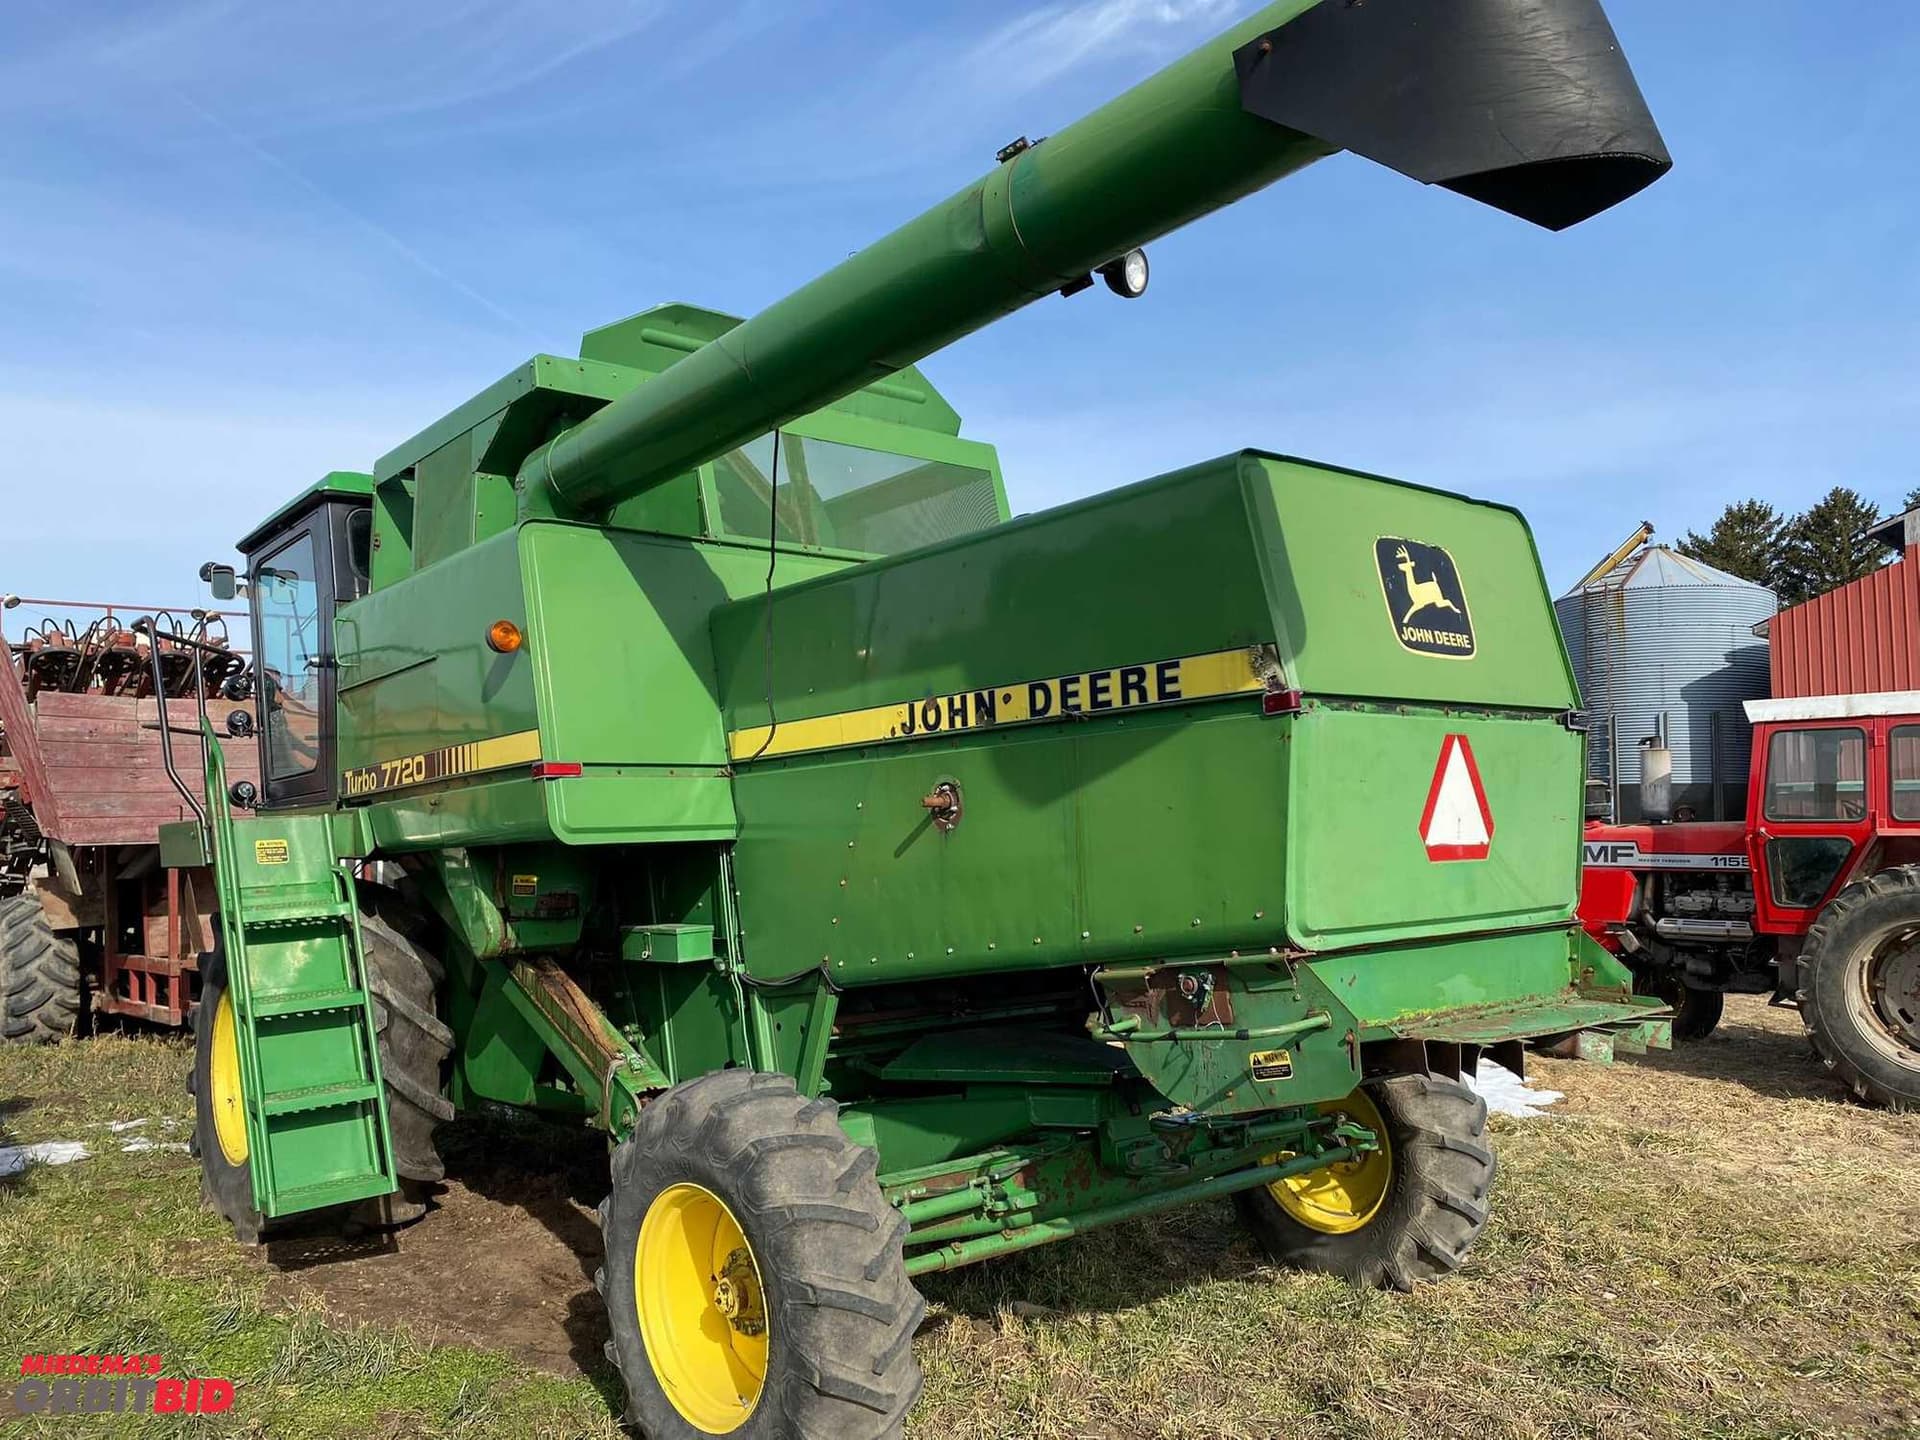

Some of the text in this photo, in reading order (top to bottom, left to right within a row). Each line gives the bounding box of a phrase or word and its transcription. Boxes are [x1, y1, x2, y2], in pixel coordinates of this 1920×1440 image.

[1401, 626, 1472, 649] JOHN DEERE
[900, 660, 1182, 736] JOHN DEERE
[345, 755, 426, 795] Turbo 7720
[1584, 845, 1635, 863] MF
[1710, 856, 1750, 867] 1155
